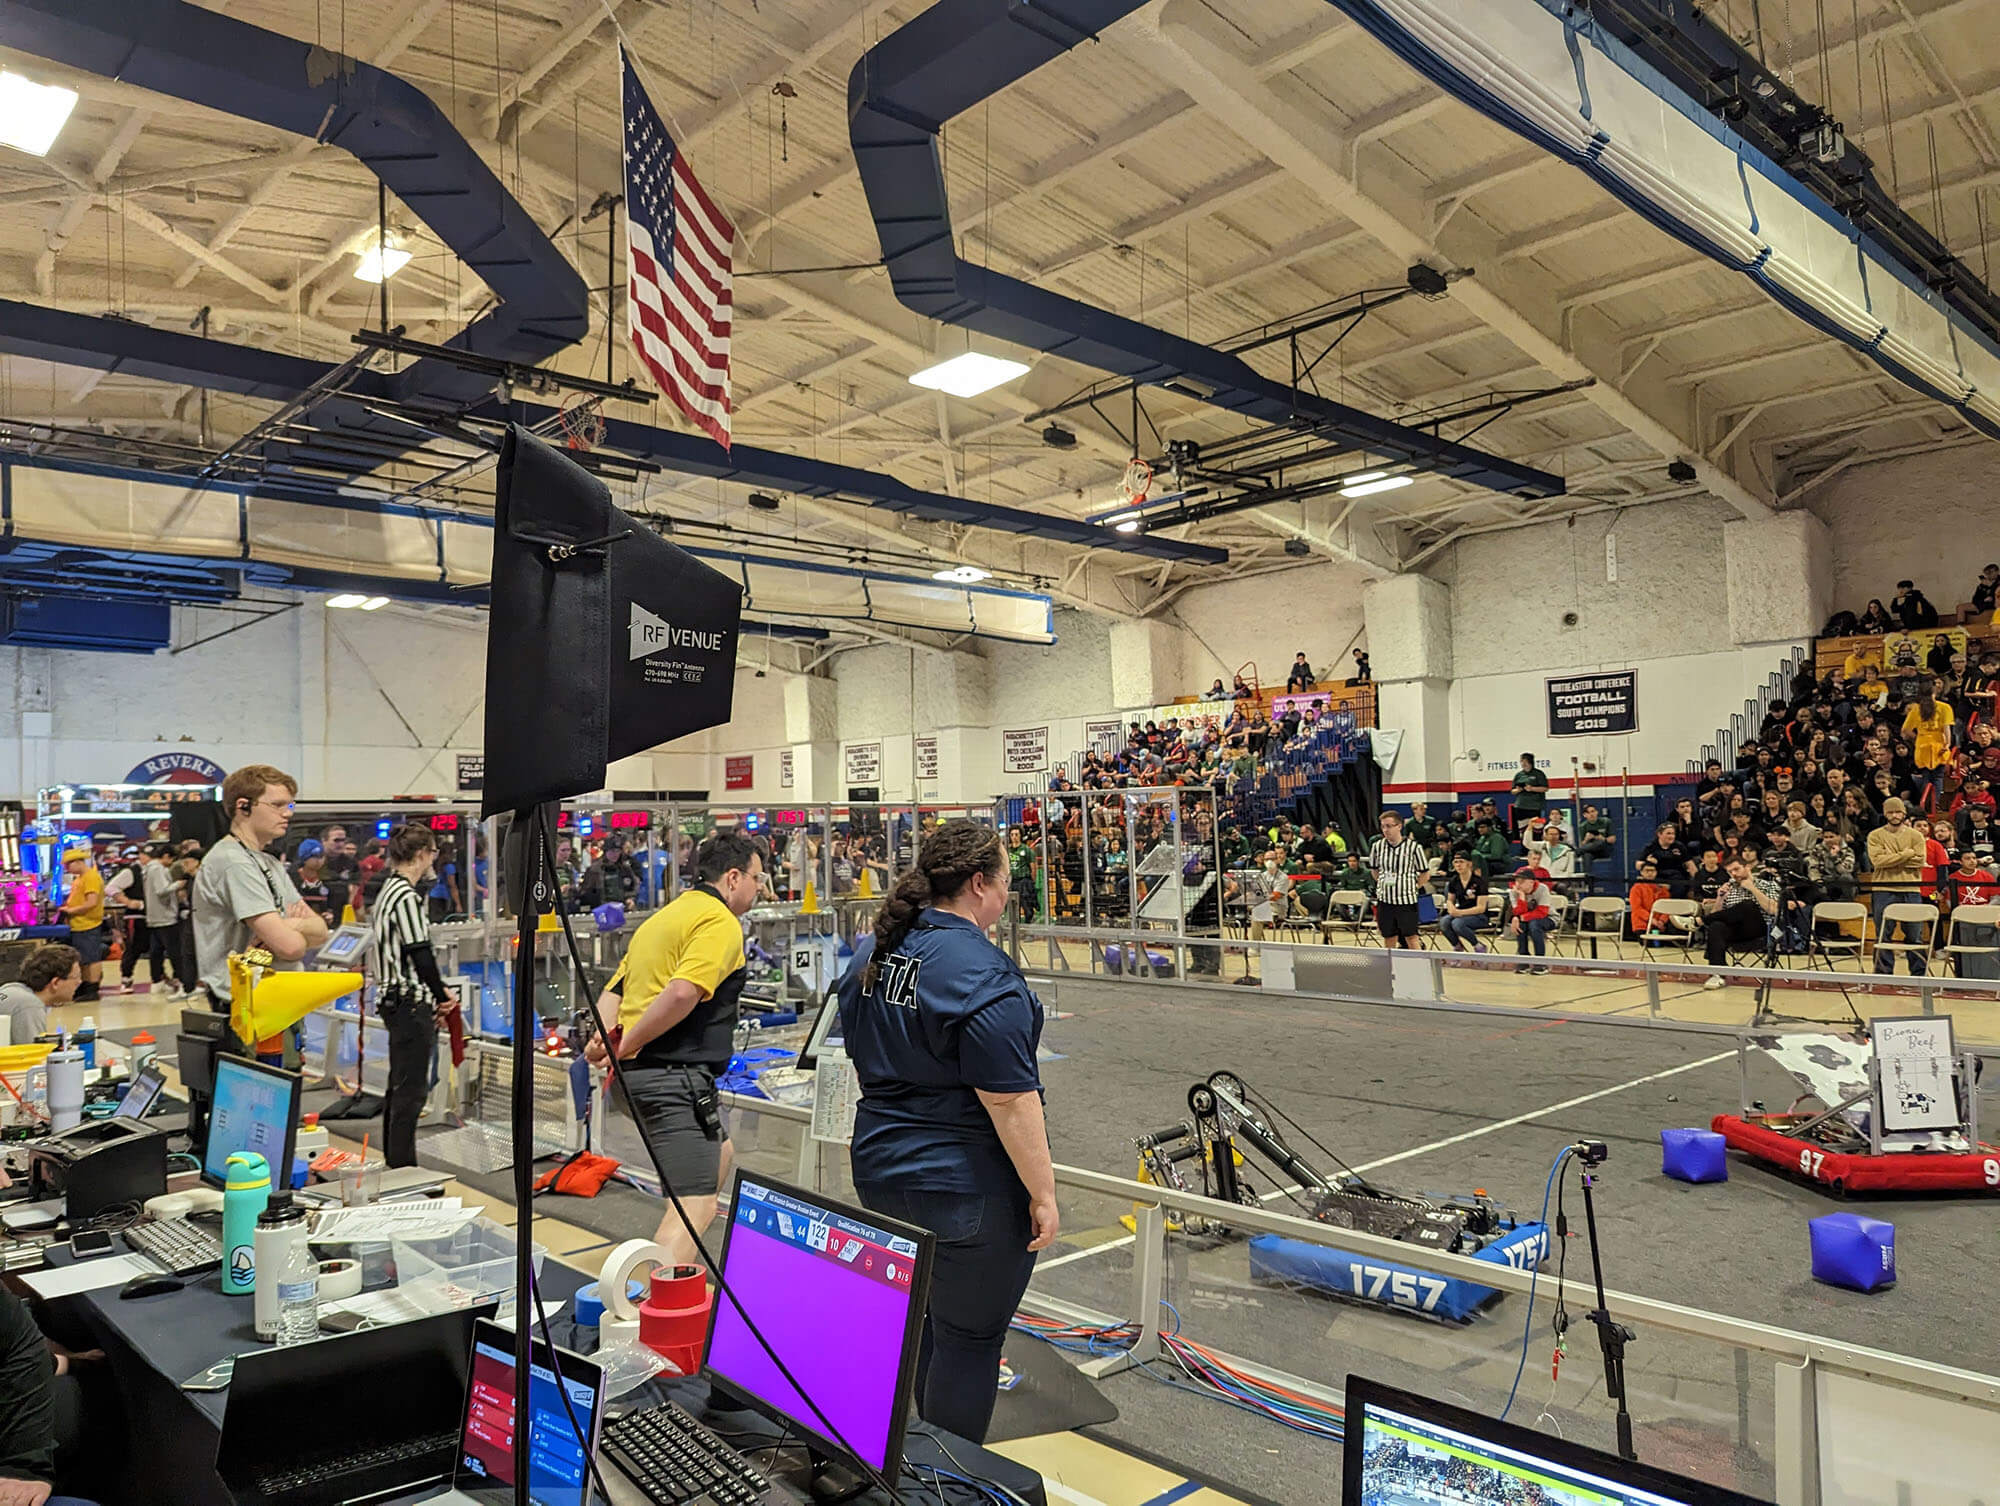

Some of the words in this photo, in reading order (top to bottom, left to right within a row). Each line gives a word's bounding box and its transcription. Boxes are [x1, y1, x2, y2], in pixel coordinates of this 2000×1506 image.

[643, 625, 665, 643] RF
[670, 628, 722, 651] VENUE
[645, 658, 671, 669] Diversity
[684, 663, 705, 672] Antenna
[1551, 680, 1593, 693] NORTHEASTERN
[1594, 676, 1631, 689] CONFERENCE
[1556, 691, 1627, 706] FOOTBALL
[1557, 707, 1582, 718] SOUTH
[1583, 704, 1626, 716] CHAMPIONS
[1575, 718, 1608, 730] 2019
[1009, 754, 1042, 762] CHAMPIONS
[1487, 761, 1518, 771] FITNESS
[1536, 759, 1551, 768] TER
[144, 755, 216, 777] REVERE
[776, 810, 805, 824] 1757
[862, 952, 922, 1009] FTA
[733, 1018, 762, 1033] 33
[1883, 1027, 1925, 1041] Bionic
[1908, 1034, 1936, 1050] Beef
[1799, 1149, 1825, 1178] 97
[1983, 1159, 2000, 1185] 9
[837, 1219, 860, 1233] Qualification
[797, 1223, 806, 1239] 44
[811, 1222, 826, 1240] 122
[829, 1237, 839, 1252] 10
[1502, 1231, 1547, 1270] 1757
[1349, 1263, 1447, 1311] 1757
